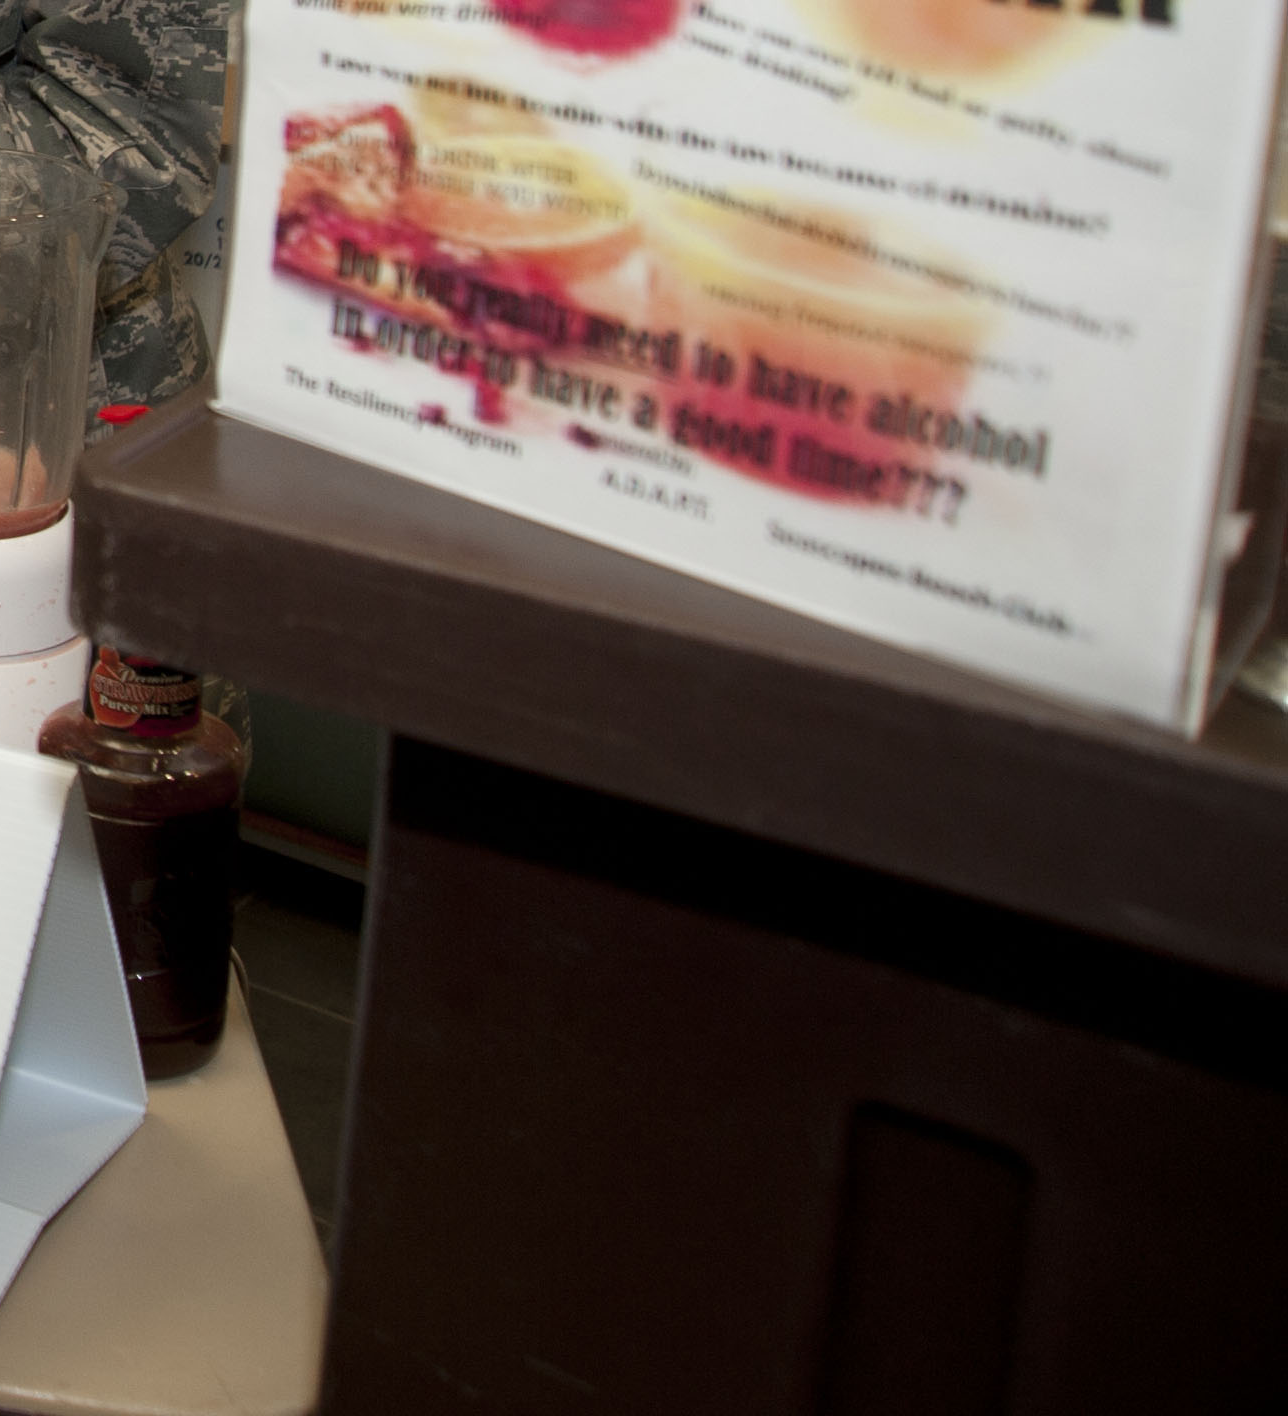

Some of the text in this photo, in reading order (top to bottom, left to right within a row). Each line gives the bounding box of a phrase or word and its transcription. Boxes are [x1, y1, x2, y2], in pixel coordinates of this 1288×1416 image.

[284, 364, 320, 393] The
[530, 357, 621, 420] have
[633, 393, 659, 431] a
[747, 350, 854, 422] have
[867, 391, 1051, 477] alcohol
[100, 694, 139, 714] Puree
